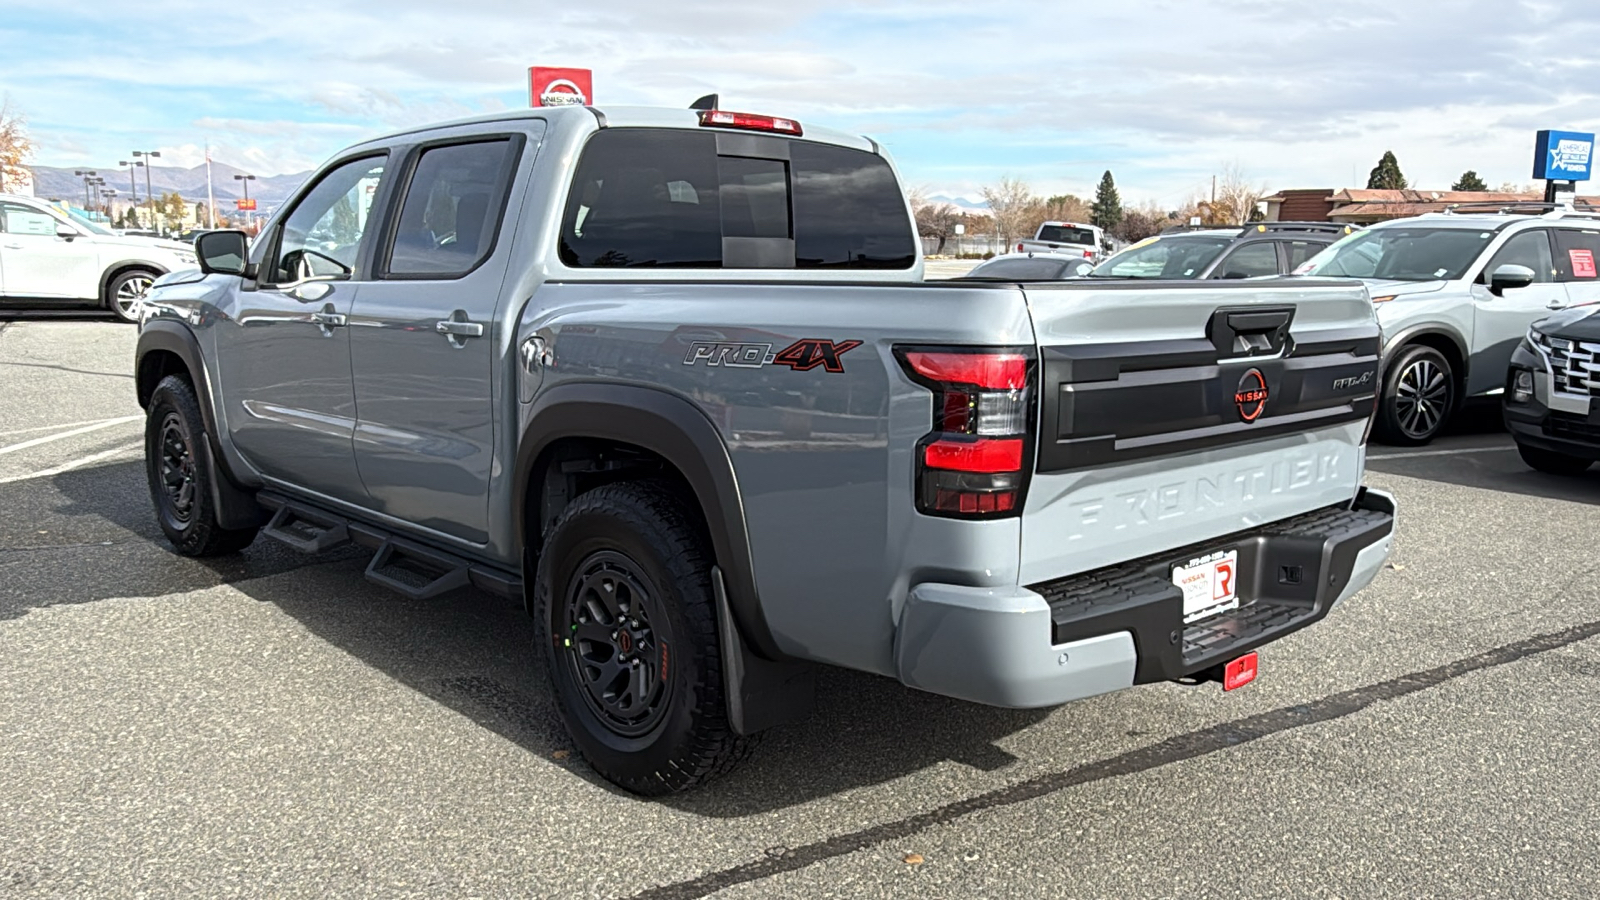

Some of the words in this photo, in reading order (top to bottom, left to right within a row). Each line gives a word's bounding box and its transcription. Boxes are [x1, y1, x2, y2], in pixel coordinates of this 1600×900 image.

[1235, 389, 1269, 403] NISSAN
[1068, 453, 1340, 541] FRONTIER
[1182, 572, 1206, 585] NISSAN
